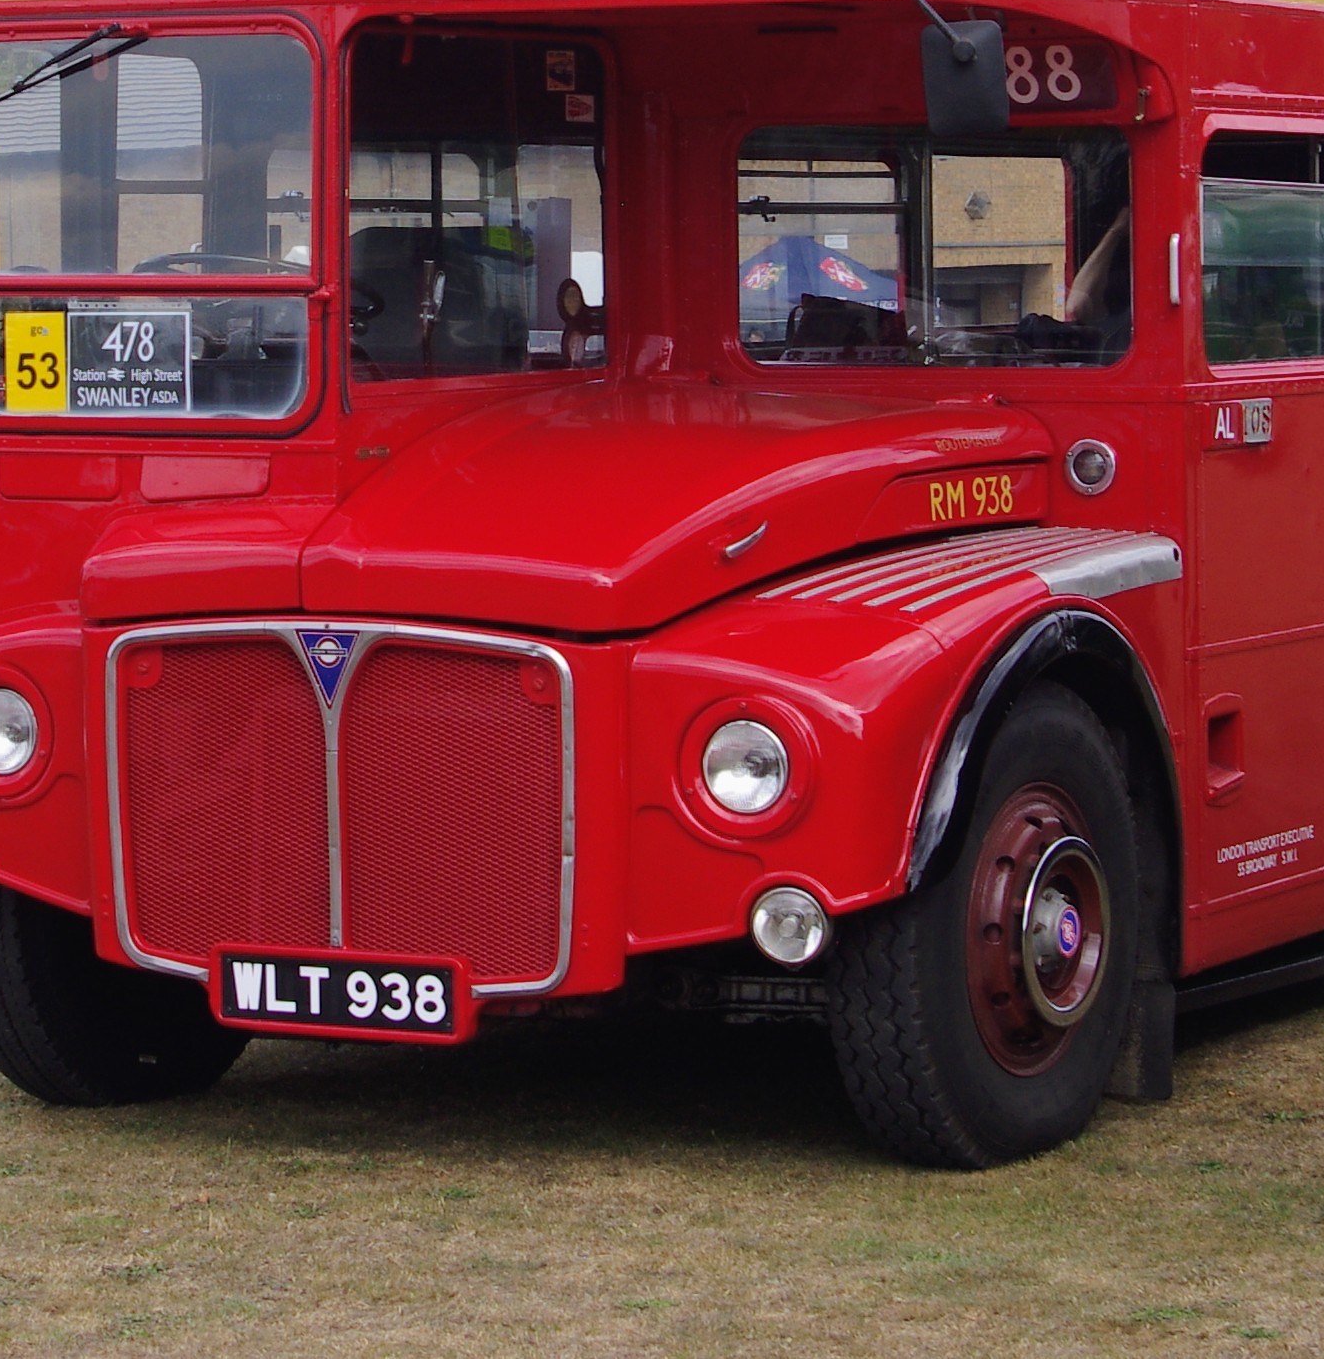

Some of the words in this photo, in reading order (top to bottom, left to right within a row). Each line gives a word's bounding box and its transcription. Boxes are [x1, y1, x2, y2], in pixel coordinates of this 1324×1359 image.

[1006, 45, 1082, 104] 88
[101, 321, 155, 362] 478
[17, 352, 60, 390] 53
[72, 368, 106, 382] Station
[131, 367, 153, 385] High
[153, 368, 183, 382] Street
[77, 386, 151, 408] SWANLEY
[151, 390, 179, 404] ASDA
[1215, 406, 1235, 440] AL
[930, 480, 966, 521] RM
[972, 474, 1013, 516] 938
[1217, 843, 1246, 863] LONDON
[1246, 833, 1280, 856] TRANSPORT
[1280, 824, 1315, 847] EXECUTIVE
[232, 961, 330, 1016] WLT
[345, 970, 448, 1024] 938
